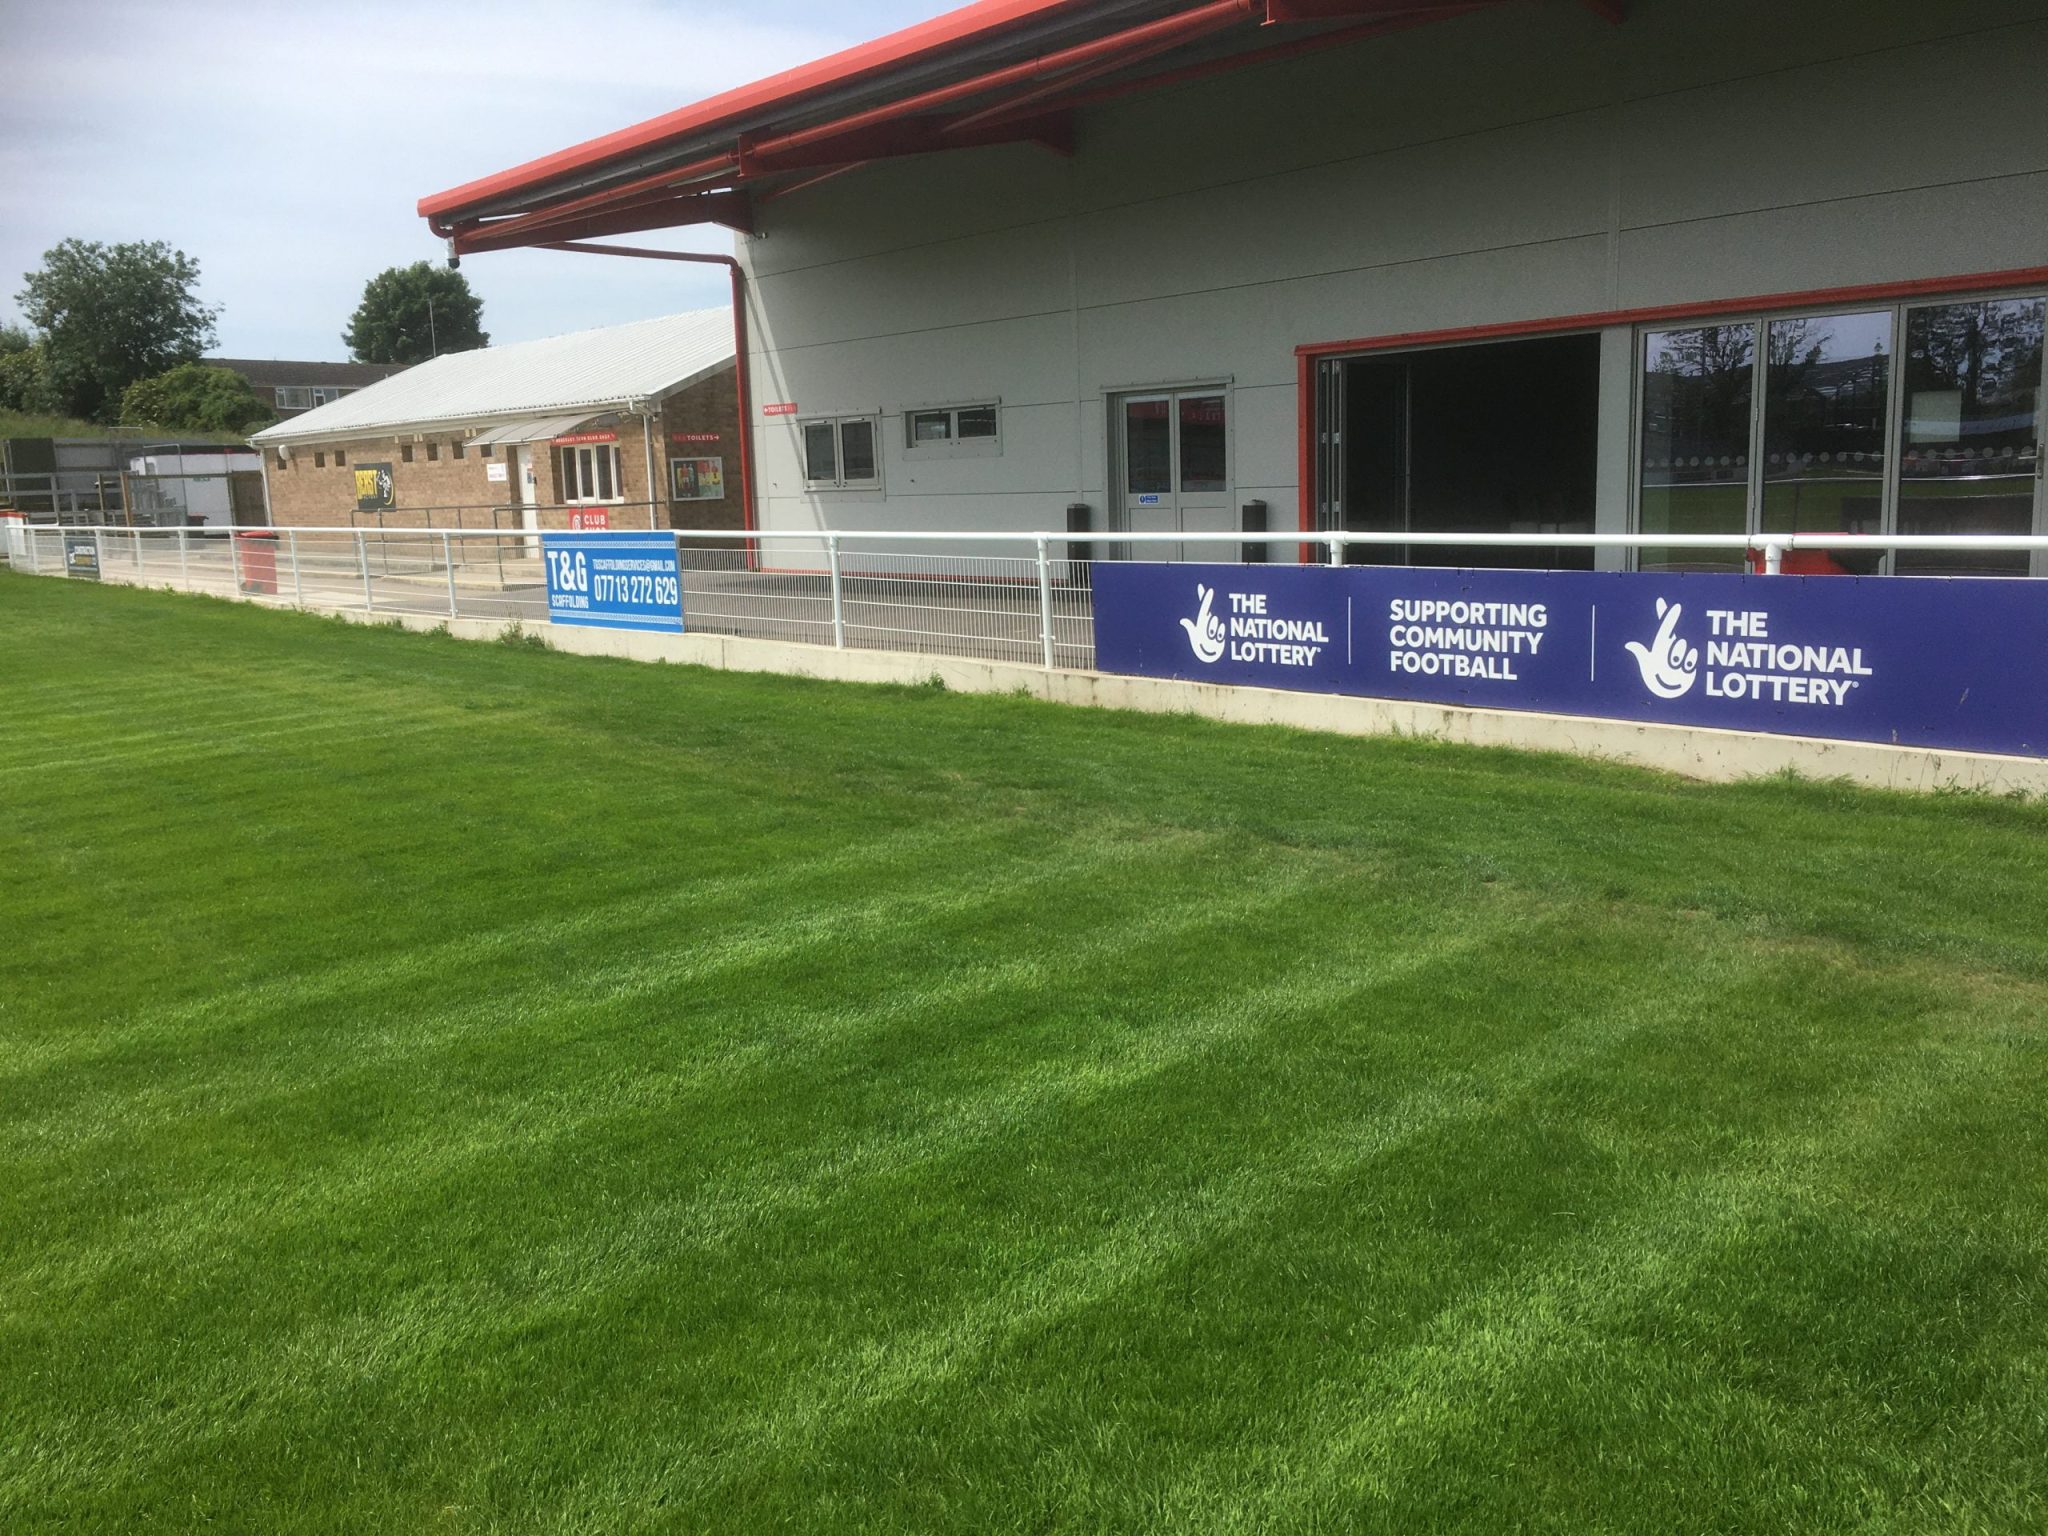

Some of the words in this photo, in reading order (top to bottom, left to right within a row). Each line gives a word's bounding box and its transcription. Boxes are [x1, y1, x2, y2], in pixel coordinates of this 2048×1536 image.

[584, 514, 606, 525] CLUB
[547, 550, 588, 592] T&G
[552, 594, 589, 609] SCAFFOLDING
[593, 574, 629, 603] 07713
[630, 575, 653, 604] 272
[655, 576, 678, 605] 629
[1228, 593, 1267, 614] THE
[1389, 598, 1548, 628] SUPPORTING
[1706, 609, 1768, 638] THE
[1230, 617, 1329, 643] NATIONAL
[1389, 624, 1544, 655] COMMUNITY
[1390, 650, 1518, 681] FOOTBALL
[1706, 640, 1873, 676] NATIONAL
